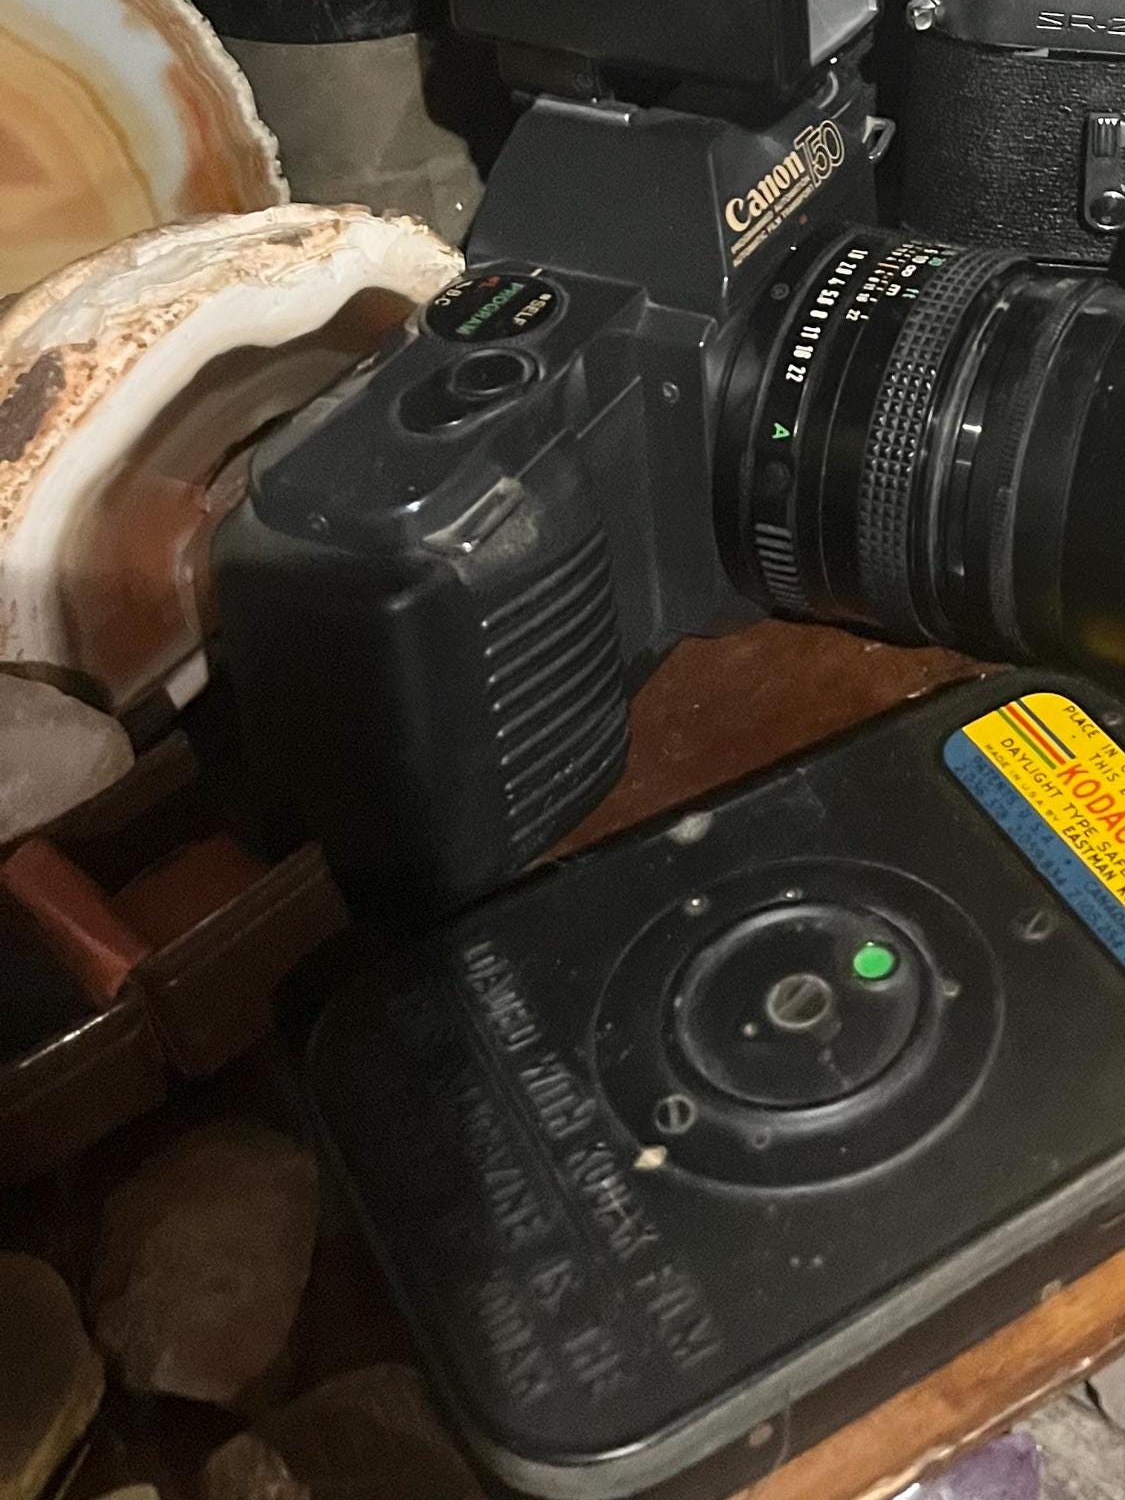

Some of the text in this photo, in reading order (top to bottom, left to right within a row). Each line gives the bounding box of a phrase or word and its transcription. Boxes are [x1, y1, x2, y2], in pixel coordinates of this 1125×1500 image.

[725, 120, 845, 232] Canon T50
[456, 282, 526, 336] PROGRAM
[801, 326, 821, 339] 11
[786, 364, 806, 382] 22
[772, 422, 790, 438] A
[1064, 705, 1099, 739] PLACE
[1101, 744, 1118, 757] IN
[1001, 738, 1063, 797] DAYLIGHT
[1063, 802, 1098, 838] TYPE
[1089, 753, 1119, 782] THIS
[983, 742, 1010, 769] MADE
[1062, 826, 1117, 881] EASTMAN
